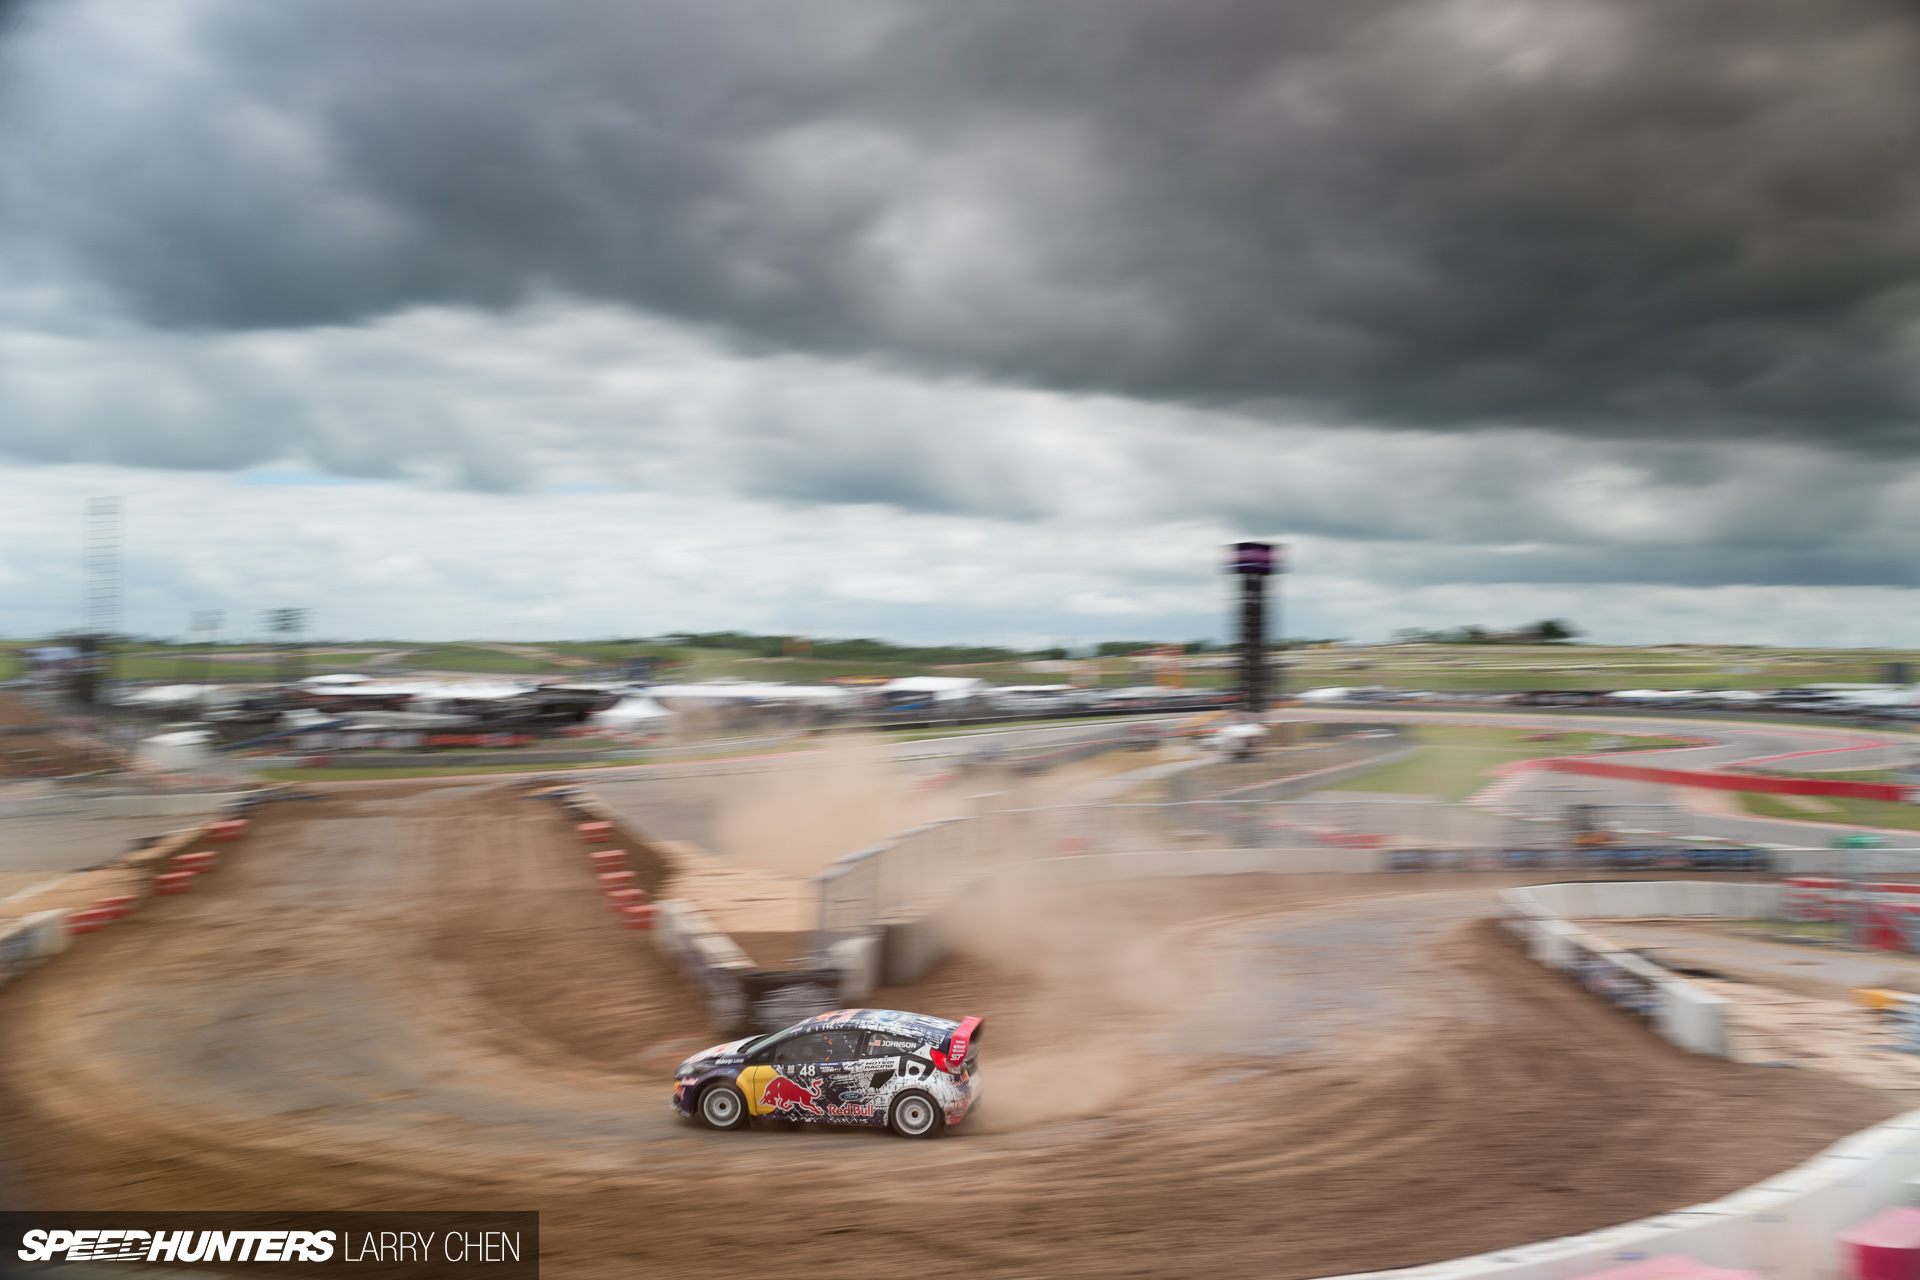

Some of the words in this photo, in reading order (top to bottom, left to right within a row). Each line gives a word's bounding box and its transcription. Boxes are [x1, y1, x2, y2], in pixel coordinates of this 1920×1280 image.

[882, 1040, 917, 1049] JOHNSON
[950, 1053, 964, 1061] ST
[800, 1065, 816, 1077] 48
[828, 1104, 851, 1115] Red
[853, 1104, 874, 1116] Bull
